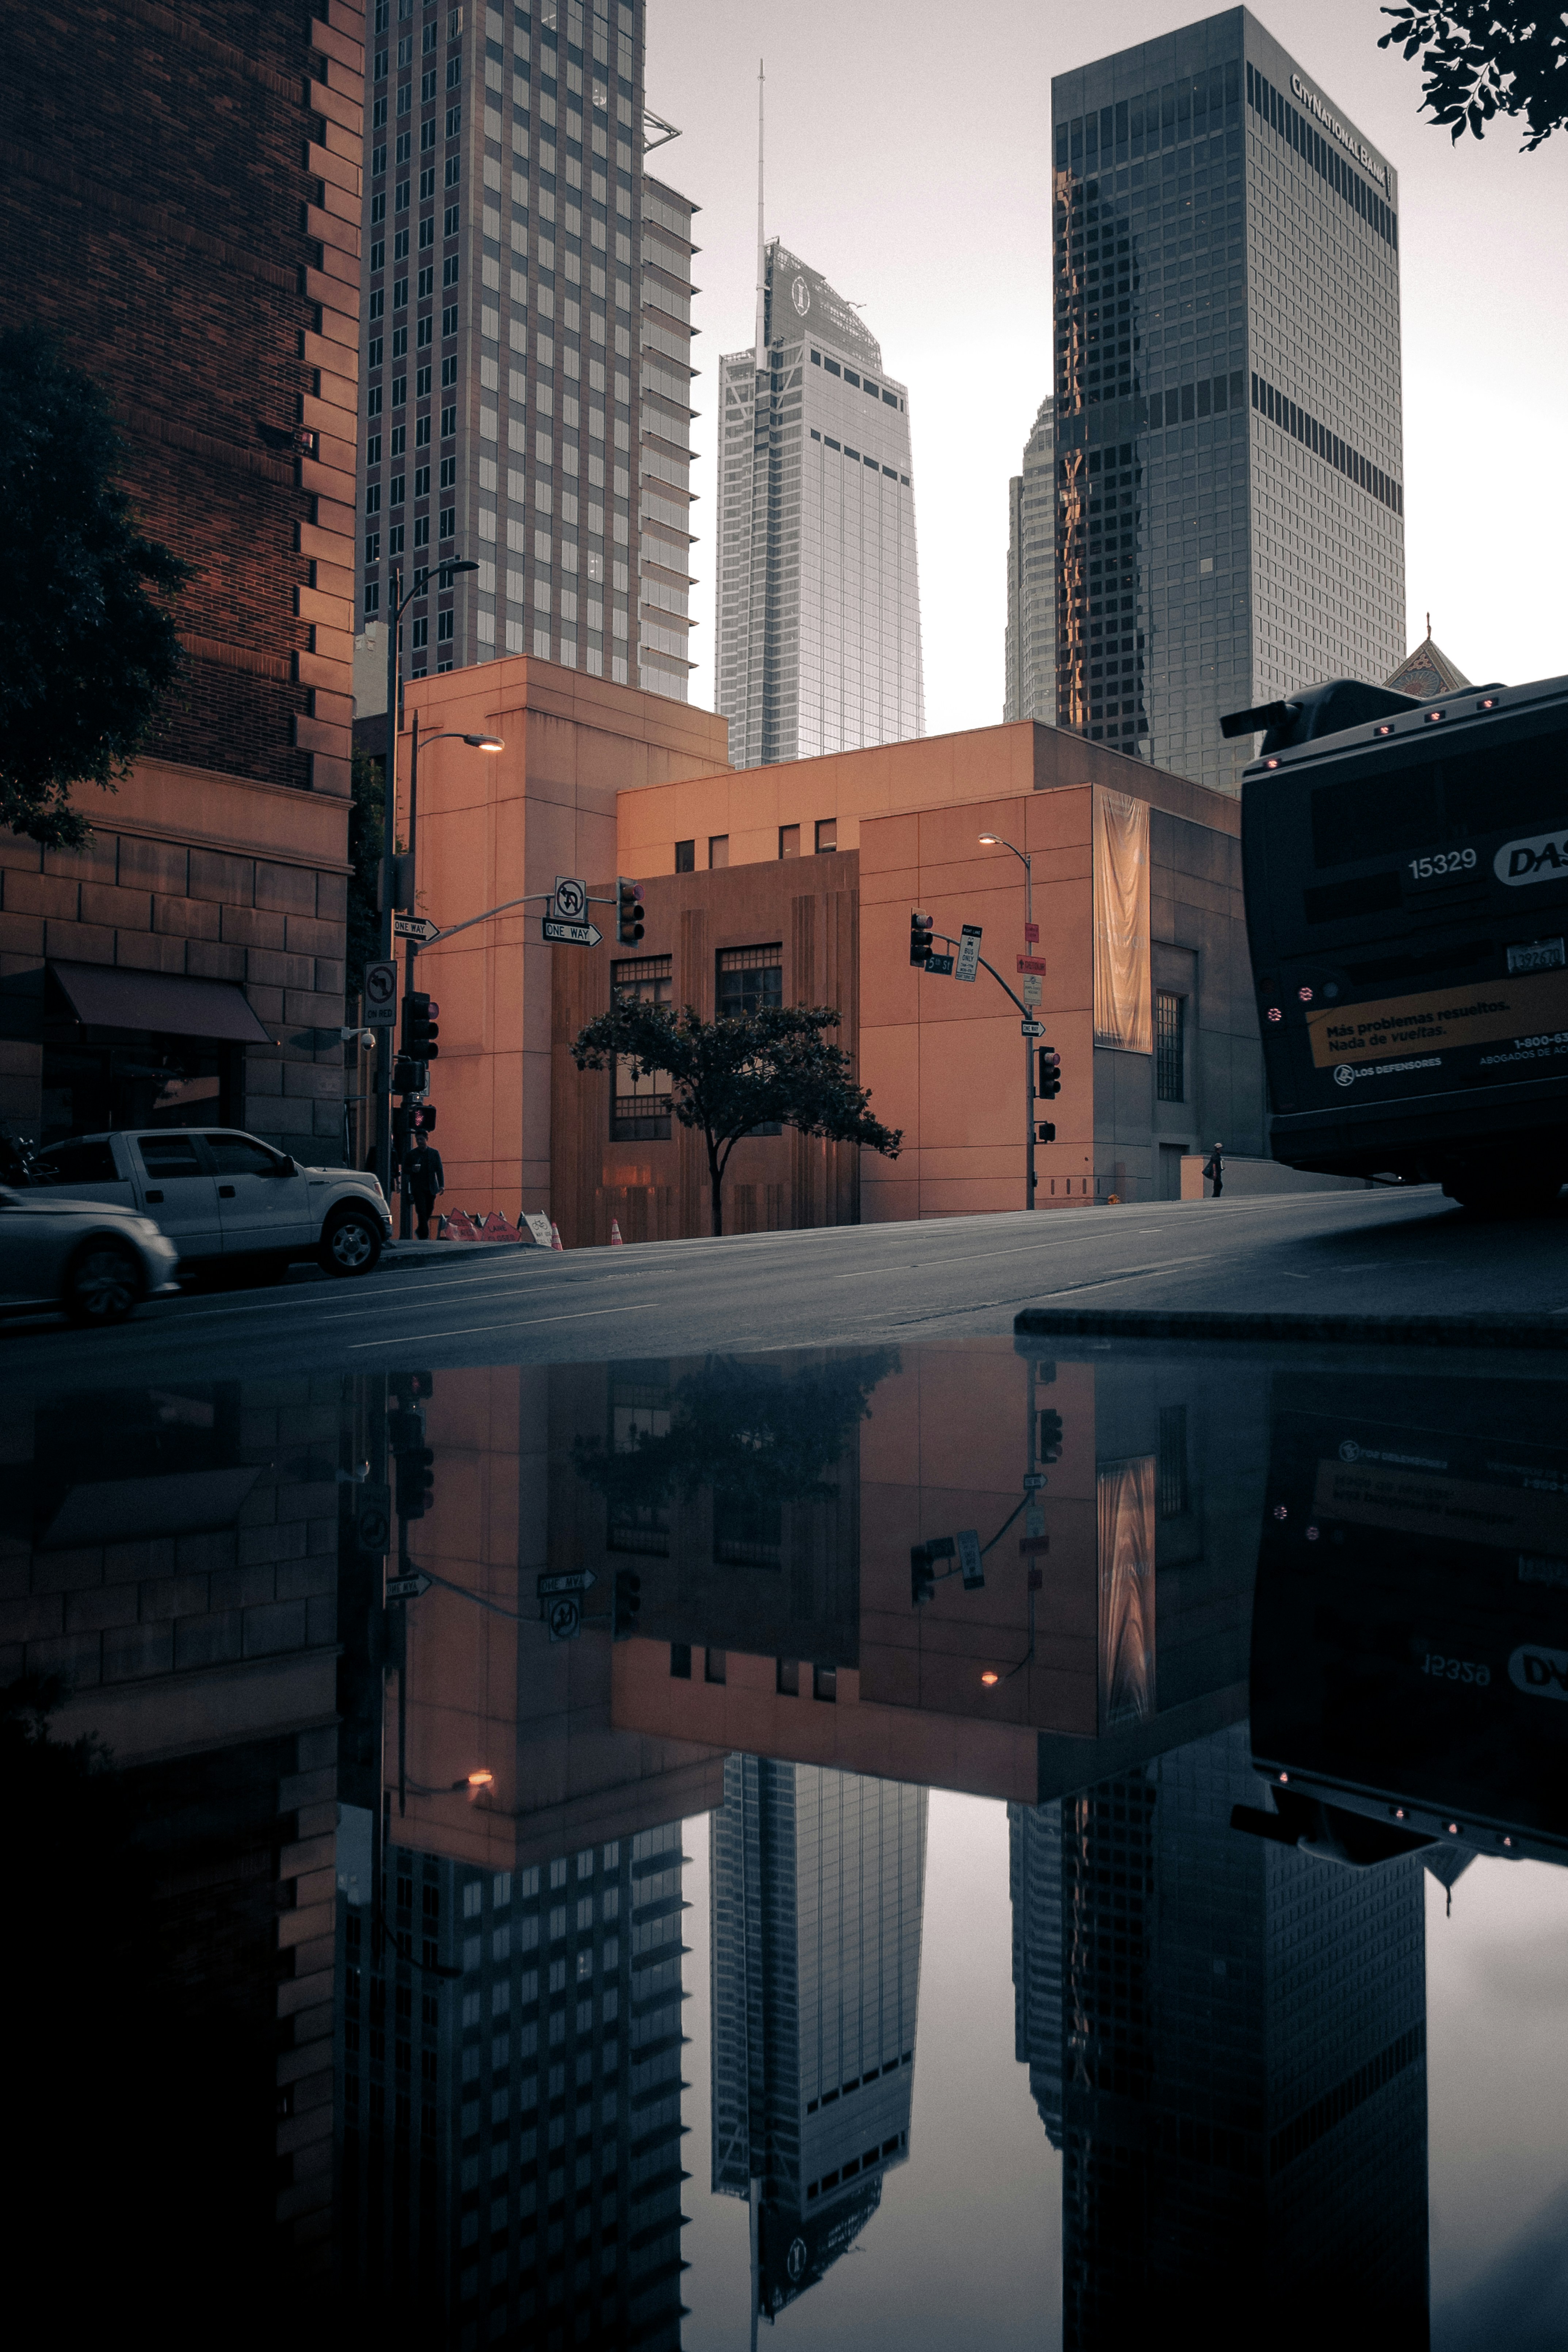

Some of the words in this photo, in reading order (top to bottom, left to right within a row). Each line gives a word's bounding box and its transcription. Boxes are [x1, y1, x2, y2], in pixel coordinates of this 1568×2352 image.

[1409, 848, 1476, 879] 15329
[1509, 840, 1568, 877] DA
[395, 921, 409, 931] ONE
[411, 923, 425, 933] WAY
[548, 924, 565, 936] ONE
[570, 928, 589, 939] WAY
[942, 960, 950, 970] St
[367, 1009, 377, 1019] ON
[379, 1009, 393, 1018] RED
[1327, 1024, 1354, 1038] Más
[1357, 1013, 1434, 1036] problemas
[1437, 1001, 1510, 1021] resueltos.
[1329, 1037, 1365, 1052] Nada
[1369, 1034, 1387, 1046] de
[1392, 1026, 1447, 1042] vueltas.
[1479, 1050, 1535, 1065] ABOGADOS
[1537, 1048, 1551, 1057] DE
[1355, 1067, 1374, 1077] LOS
[1375, 1057, 1442, 1074] DEFENSORES
